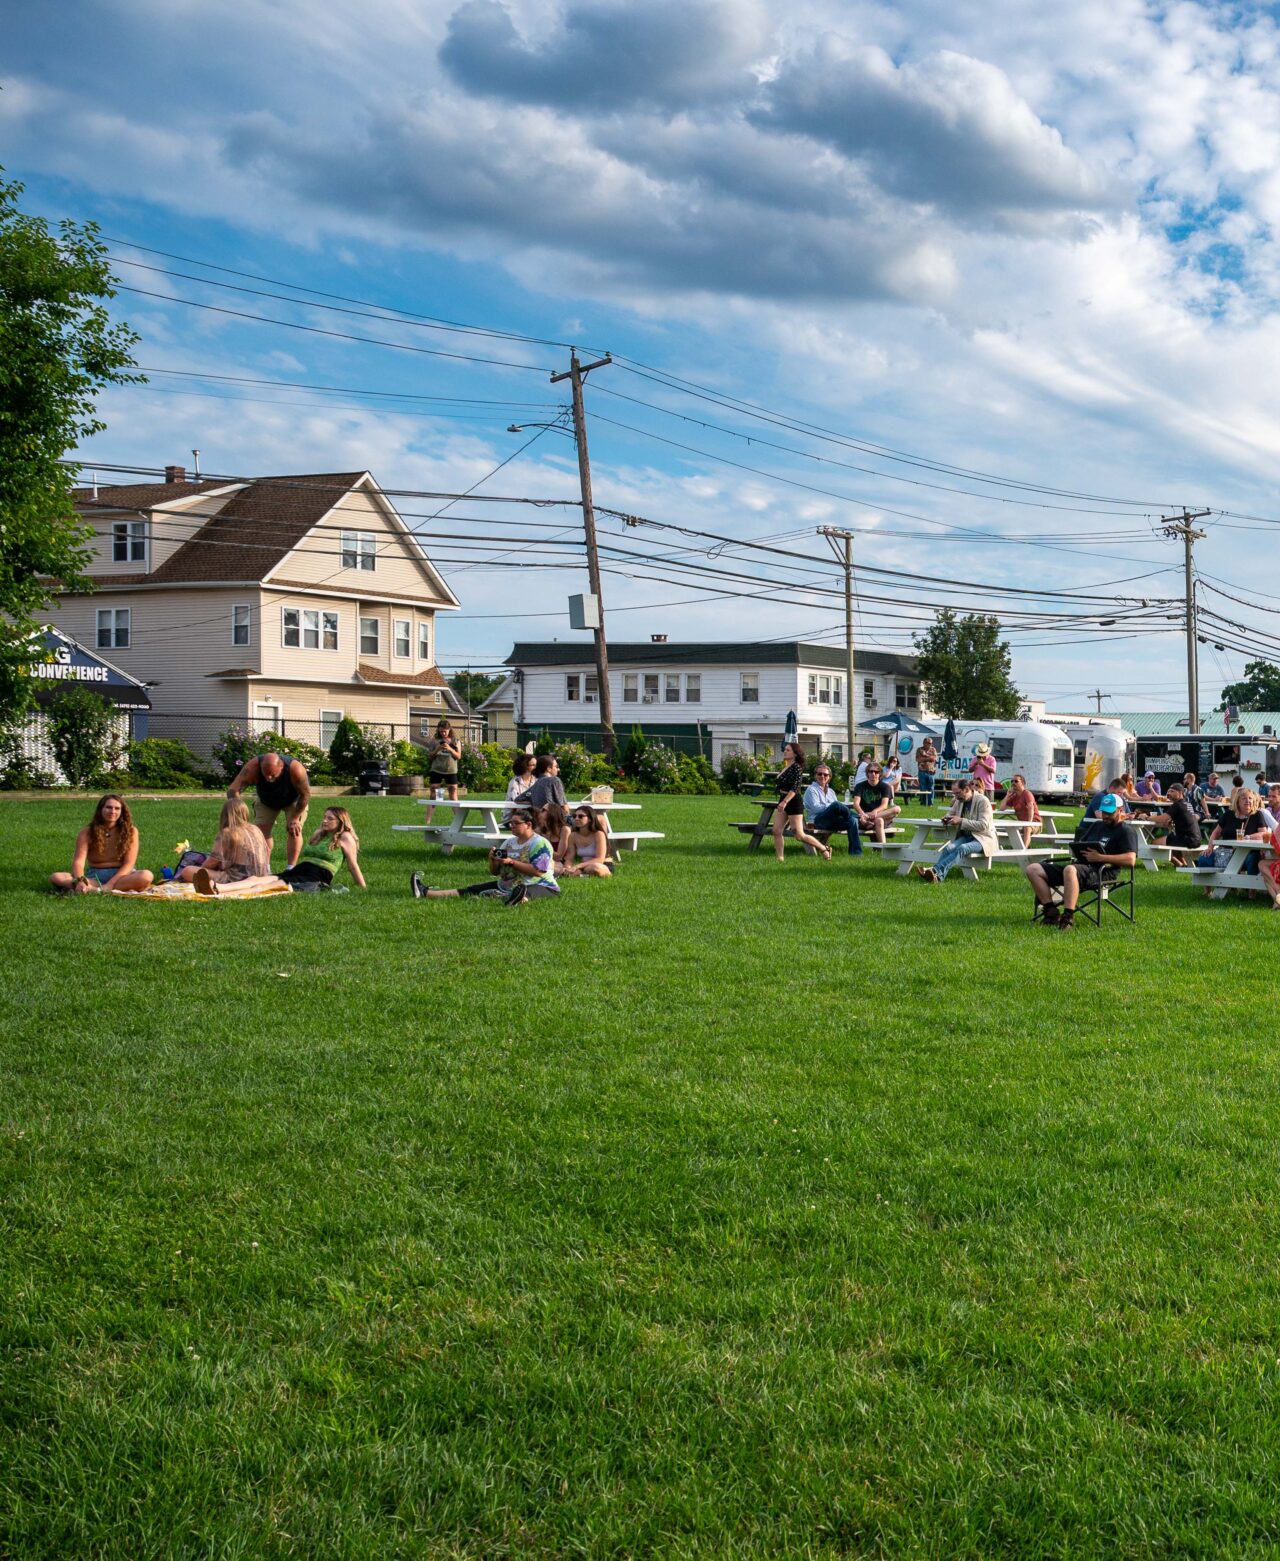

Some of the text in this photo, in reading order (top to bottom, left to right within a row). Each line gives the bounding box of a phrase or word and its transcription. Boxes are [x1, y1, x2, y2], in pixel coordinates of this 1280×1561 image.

[55, 646, 71, 664] G
[936, 756, 973, 771] H2ROA
[1145, 764, 1185, 773] UNDERGROUND
